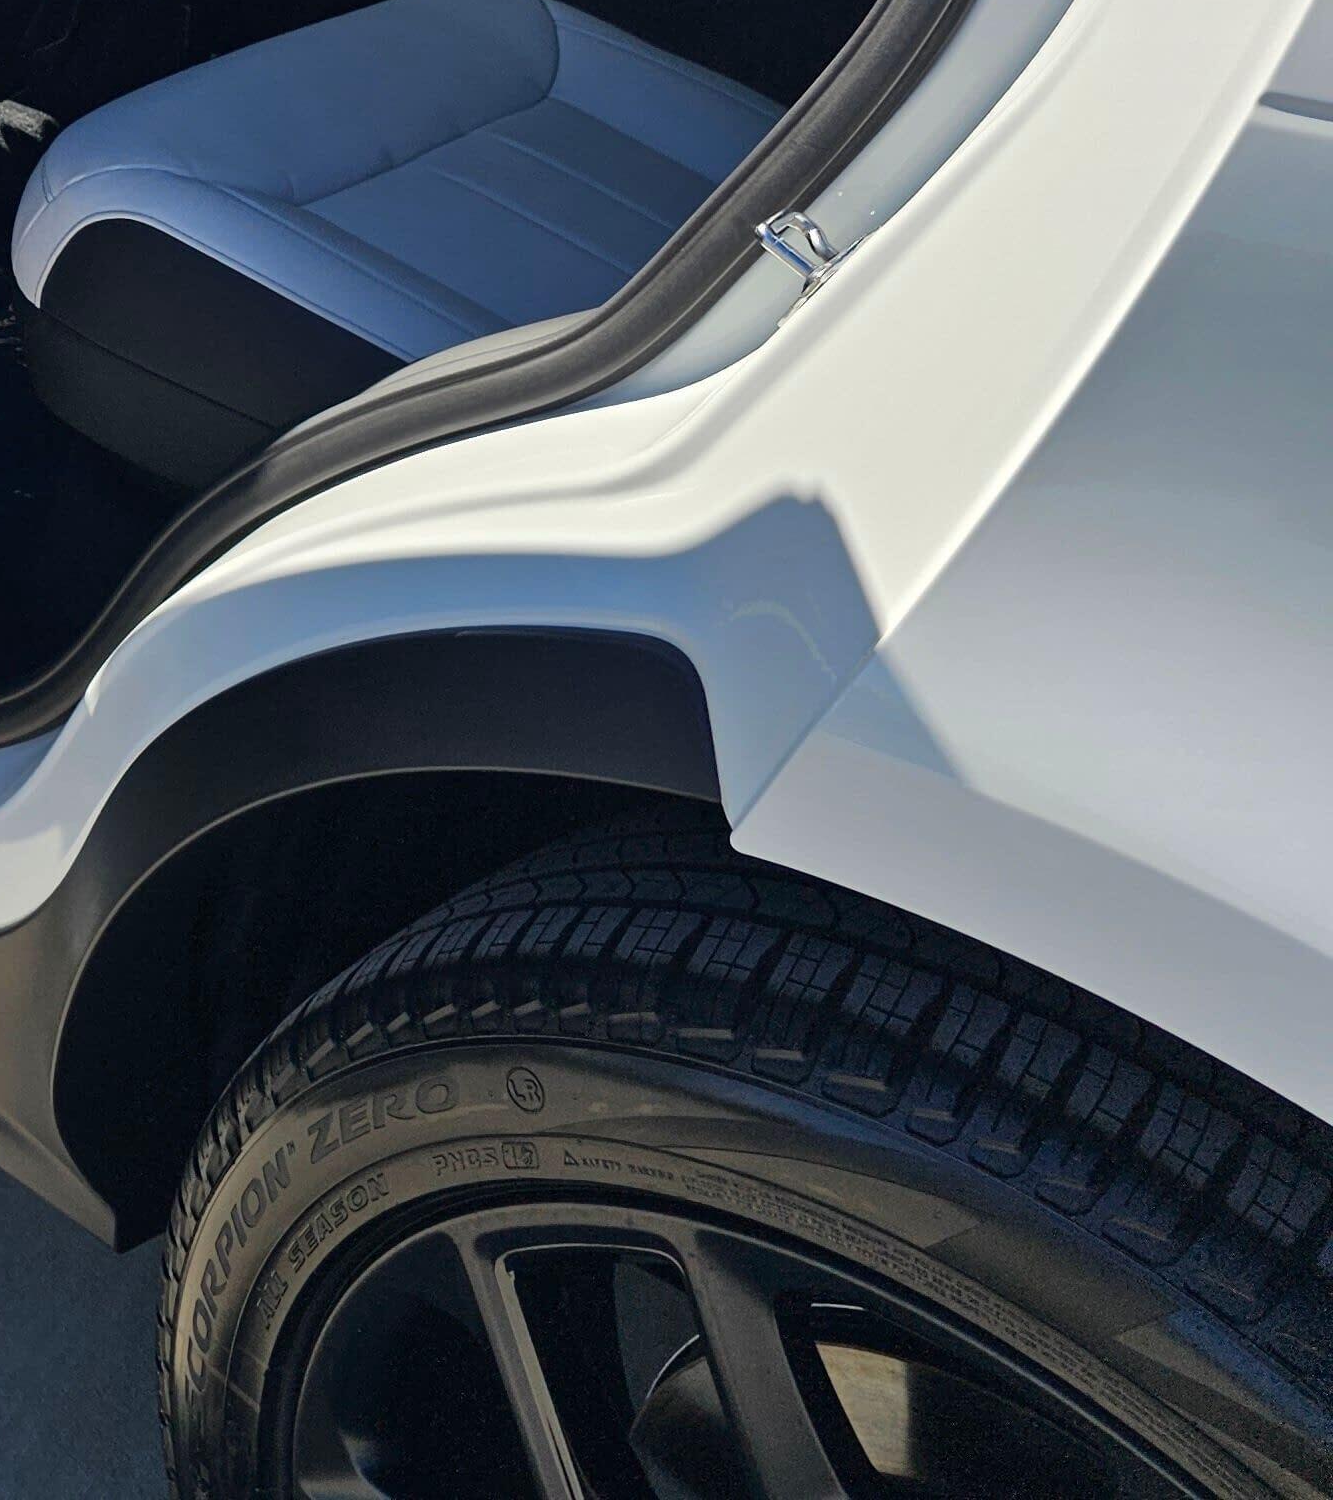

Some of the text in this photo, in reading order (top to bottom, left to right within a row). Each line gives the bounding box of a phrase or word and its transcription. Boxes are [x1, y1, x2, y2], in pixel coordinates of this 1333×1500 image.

[306, 1074, 460, 1166] ZERO
[257, 1171, 389, 1331] ALL SEASON
